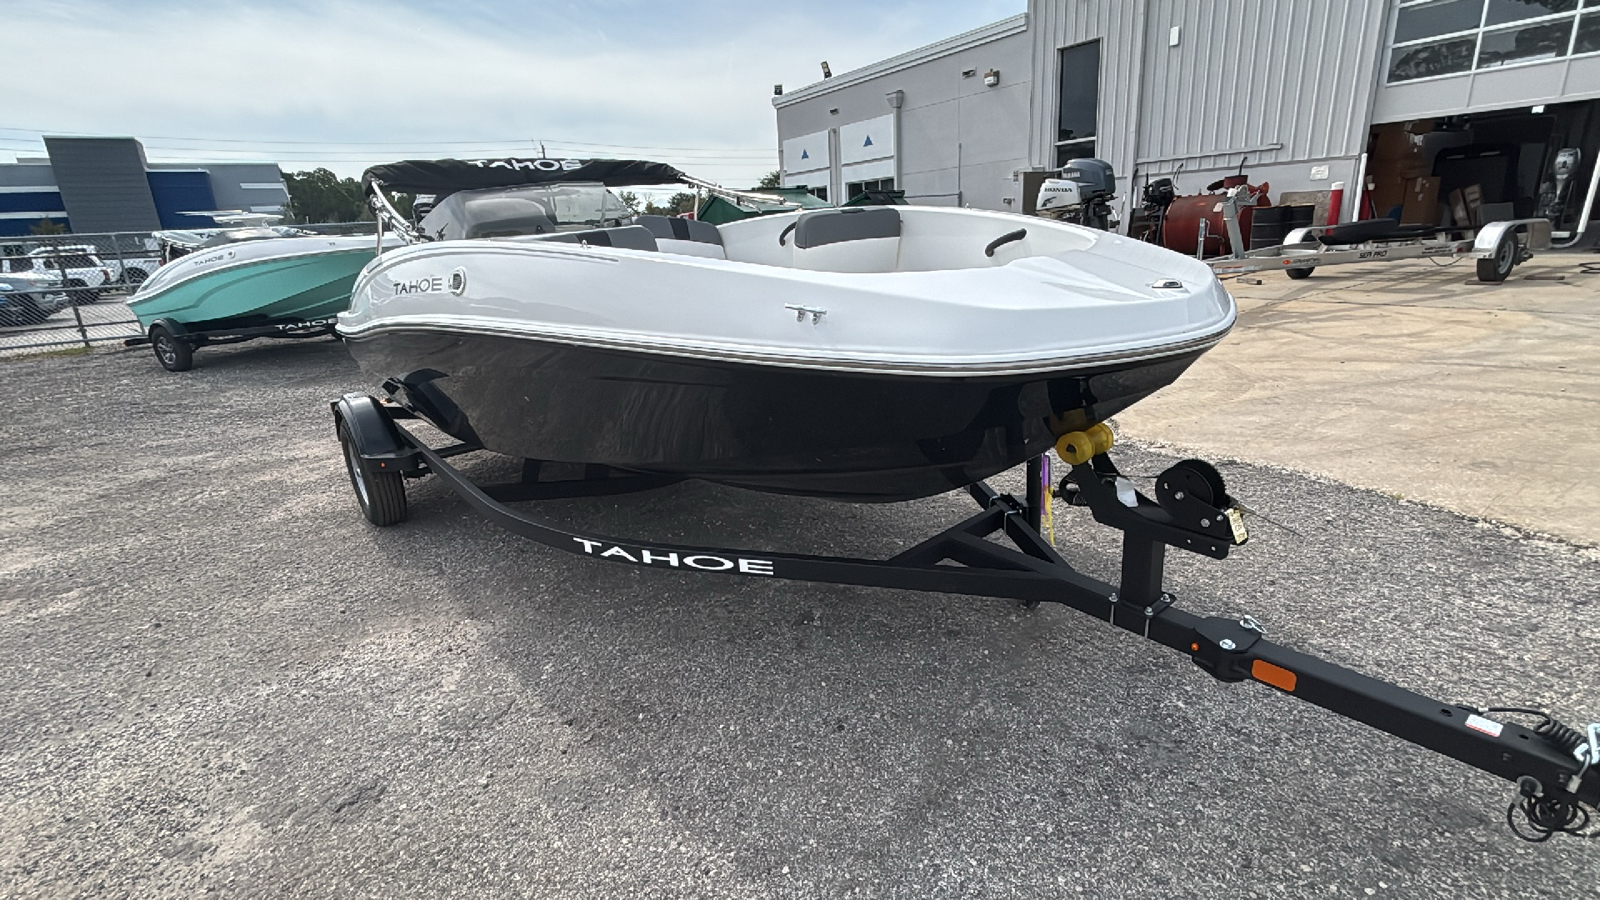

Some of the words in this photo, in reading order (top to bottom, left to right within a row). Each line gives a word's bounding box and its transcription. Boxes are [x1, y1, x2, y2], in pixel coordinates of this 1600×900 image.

[466, 159, 582, 171] TAHOE
[194, 255, 224, 266] TAHOE
[393, 277, 442, 295] TAHOE
[573, 537, 774, 575] TAHOE
